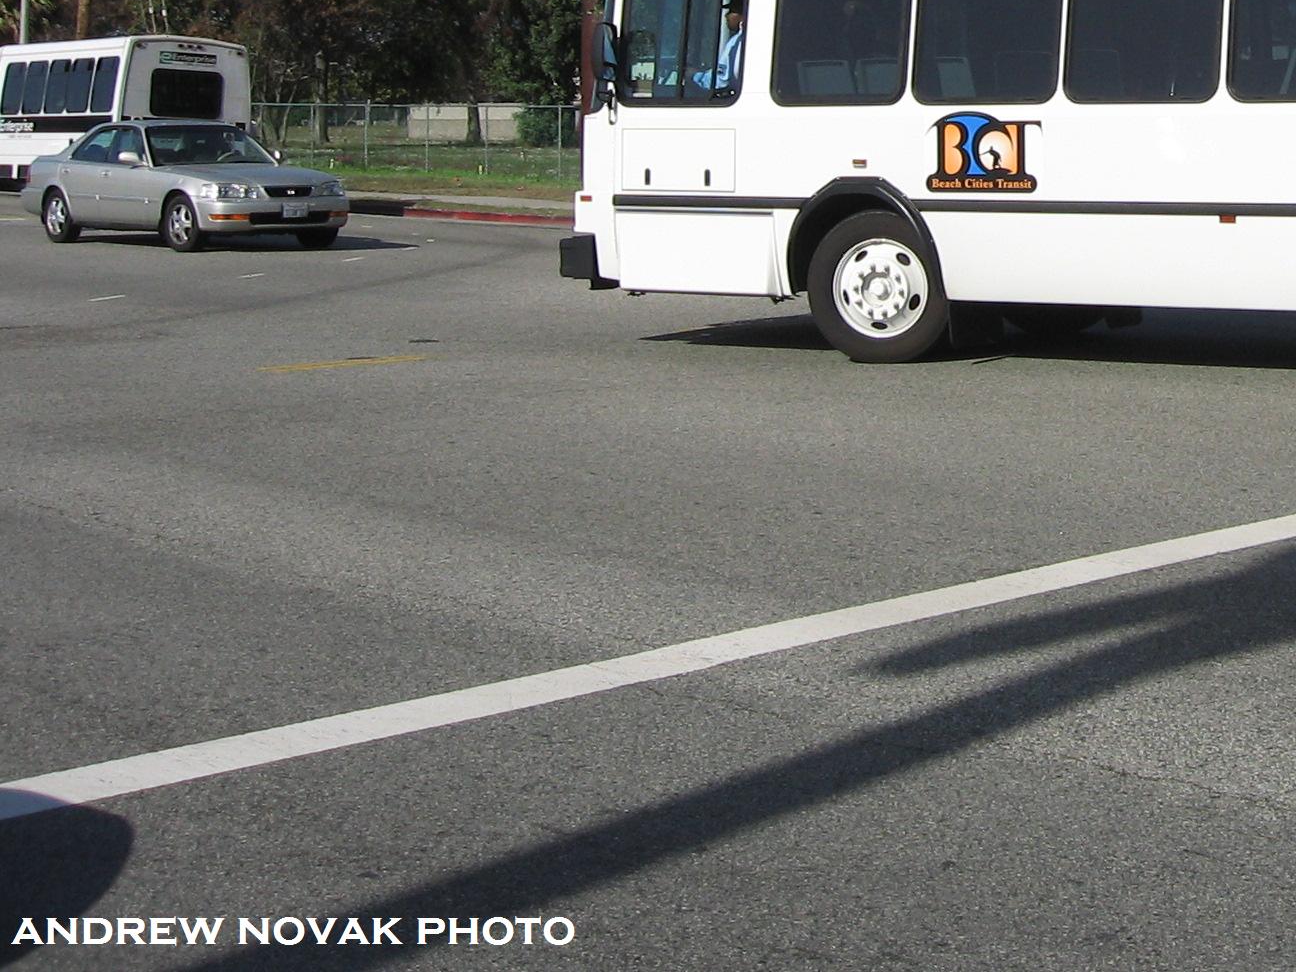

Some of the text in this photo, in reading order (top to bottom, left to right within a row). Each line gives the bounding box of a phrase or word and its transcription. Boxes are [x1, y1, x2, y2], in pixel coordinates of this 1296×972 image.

[931, 178, 1032, 189] Beach Cities Transit
